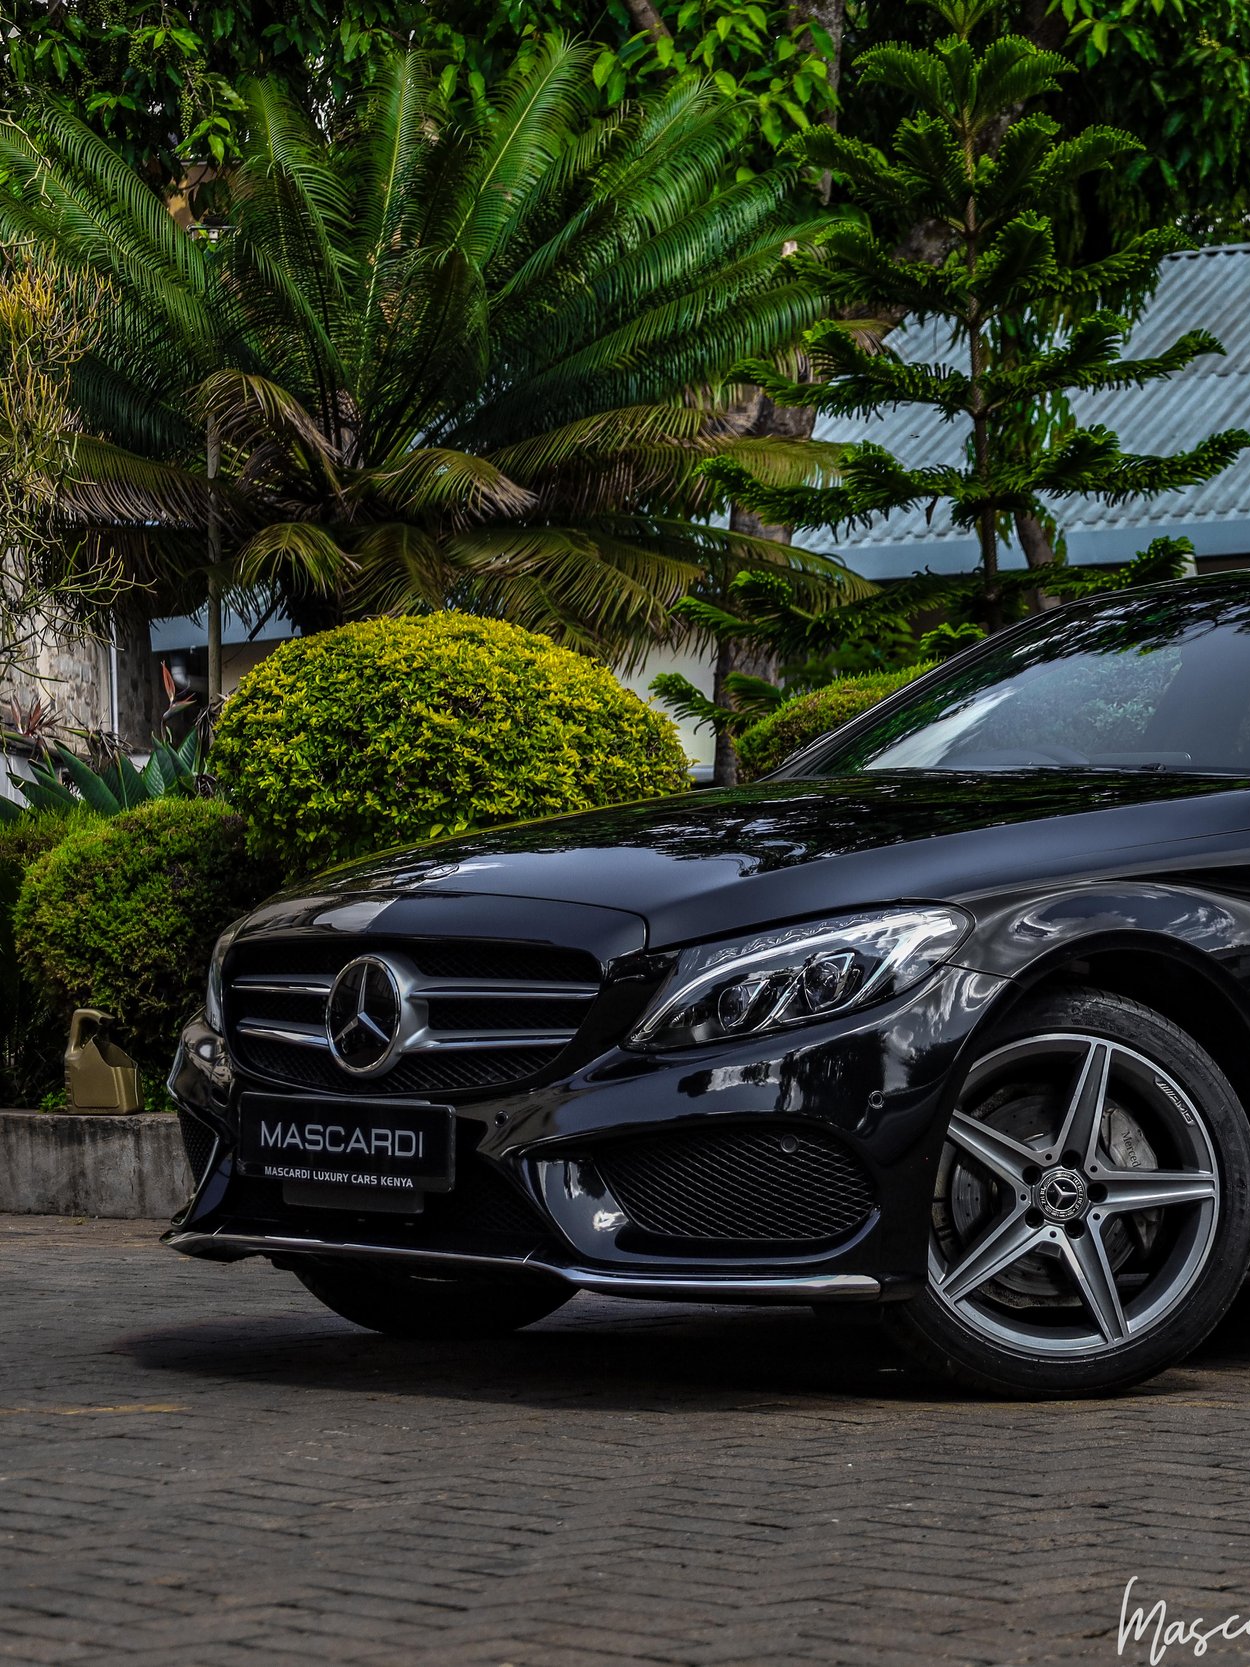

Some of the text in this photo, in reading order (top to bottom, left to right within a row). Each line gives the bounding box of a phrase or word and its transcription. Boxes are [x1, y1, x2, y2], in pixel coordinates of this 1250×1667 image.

[260, 1120, 424, 1158] MASCARDI
[264, 1165, 414, 1188] MASCARDI LUXURY CARS KENYA
